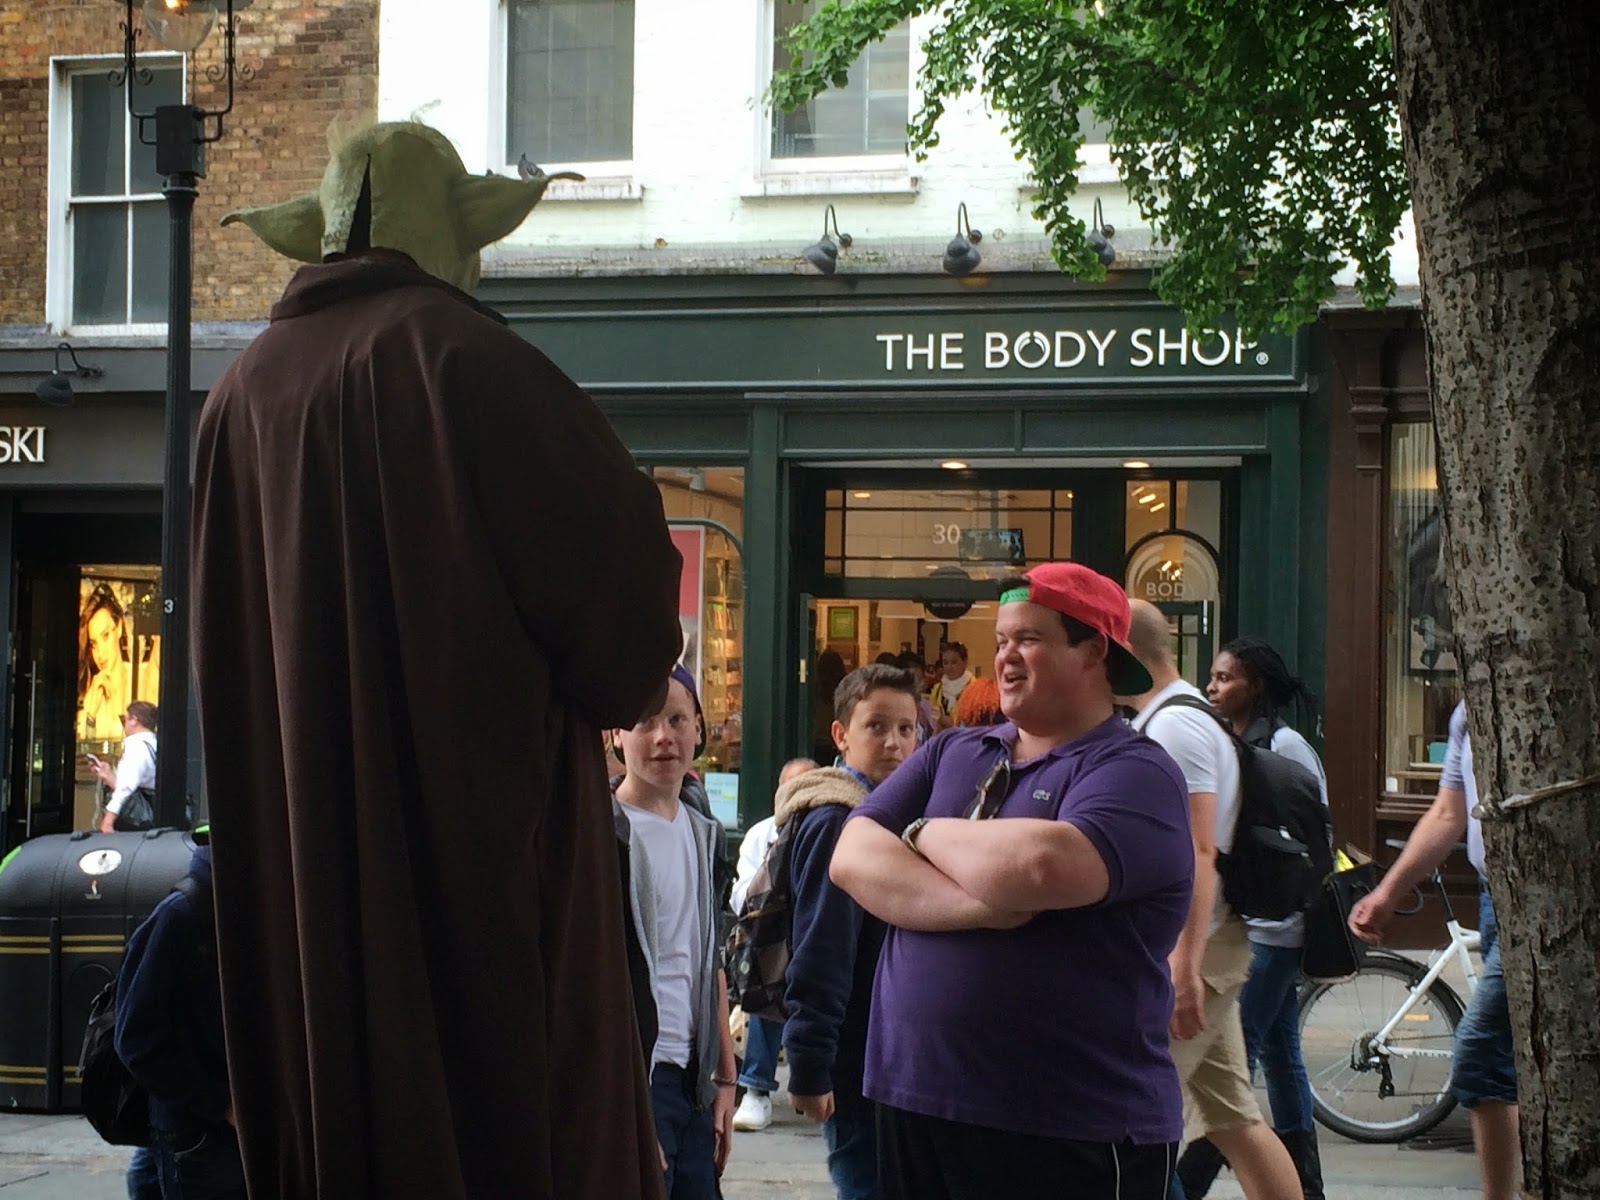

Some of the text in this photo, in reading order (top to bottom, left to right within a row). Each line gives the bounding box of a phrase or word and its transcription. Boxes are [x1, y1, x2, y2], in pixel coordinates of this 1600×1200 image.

[876, 332, 964, 370] THE
[985, 328, 1117, 369] BODY
[1130, 326, 1258, 367] SHOP
[0, 426, 46, 463] SKI
[932, 523, 961, 545] 30
[1145, 581, 1195, 597] BOD
[164, 599, 174, 614] 3
